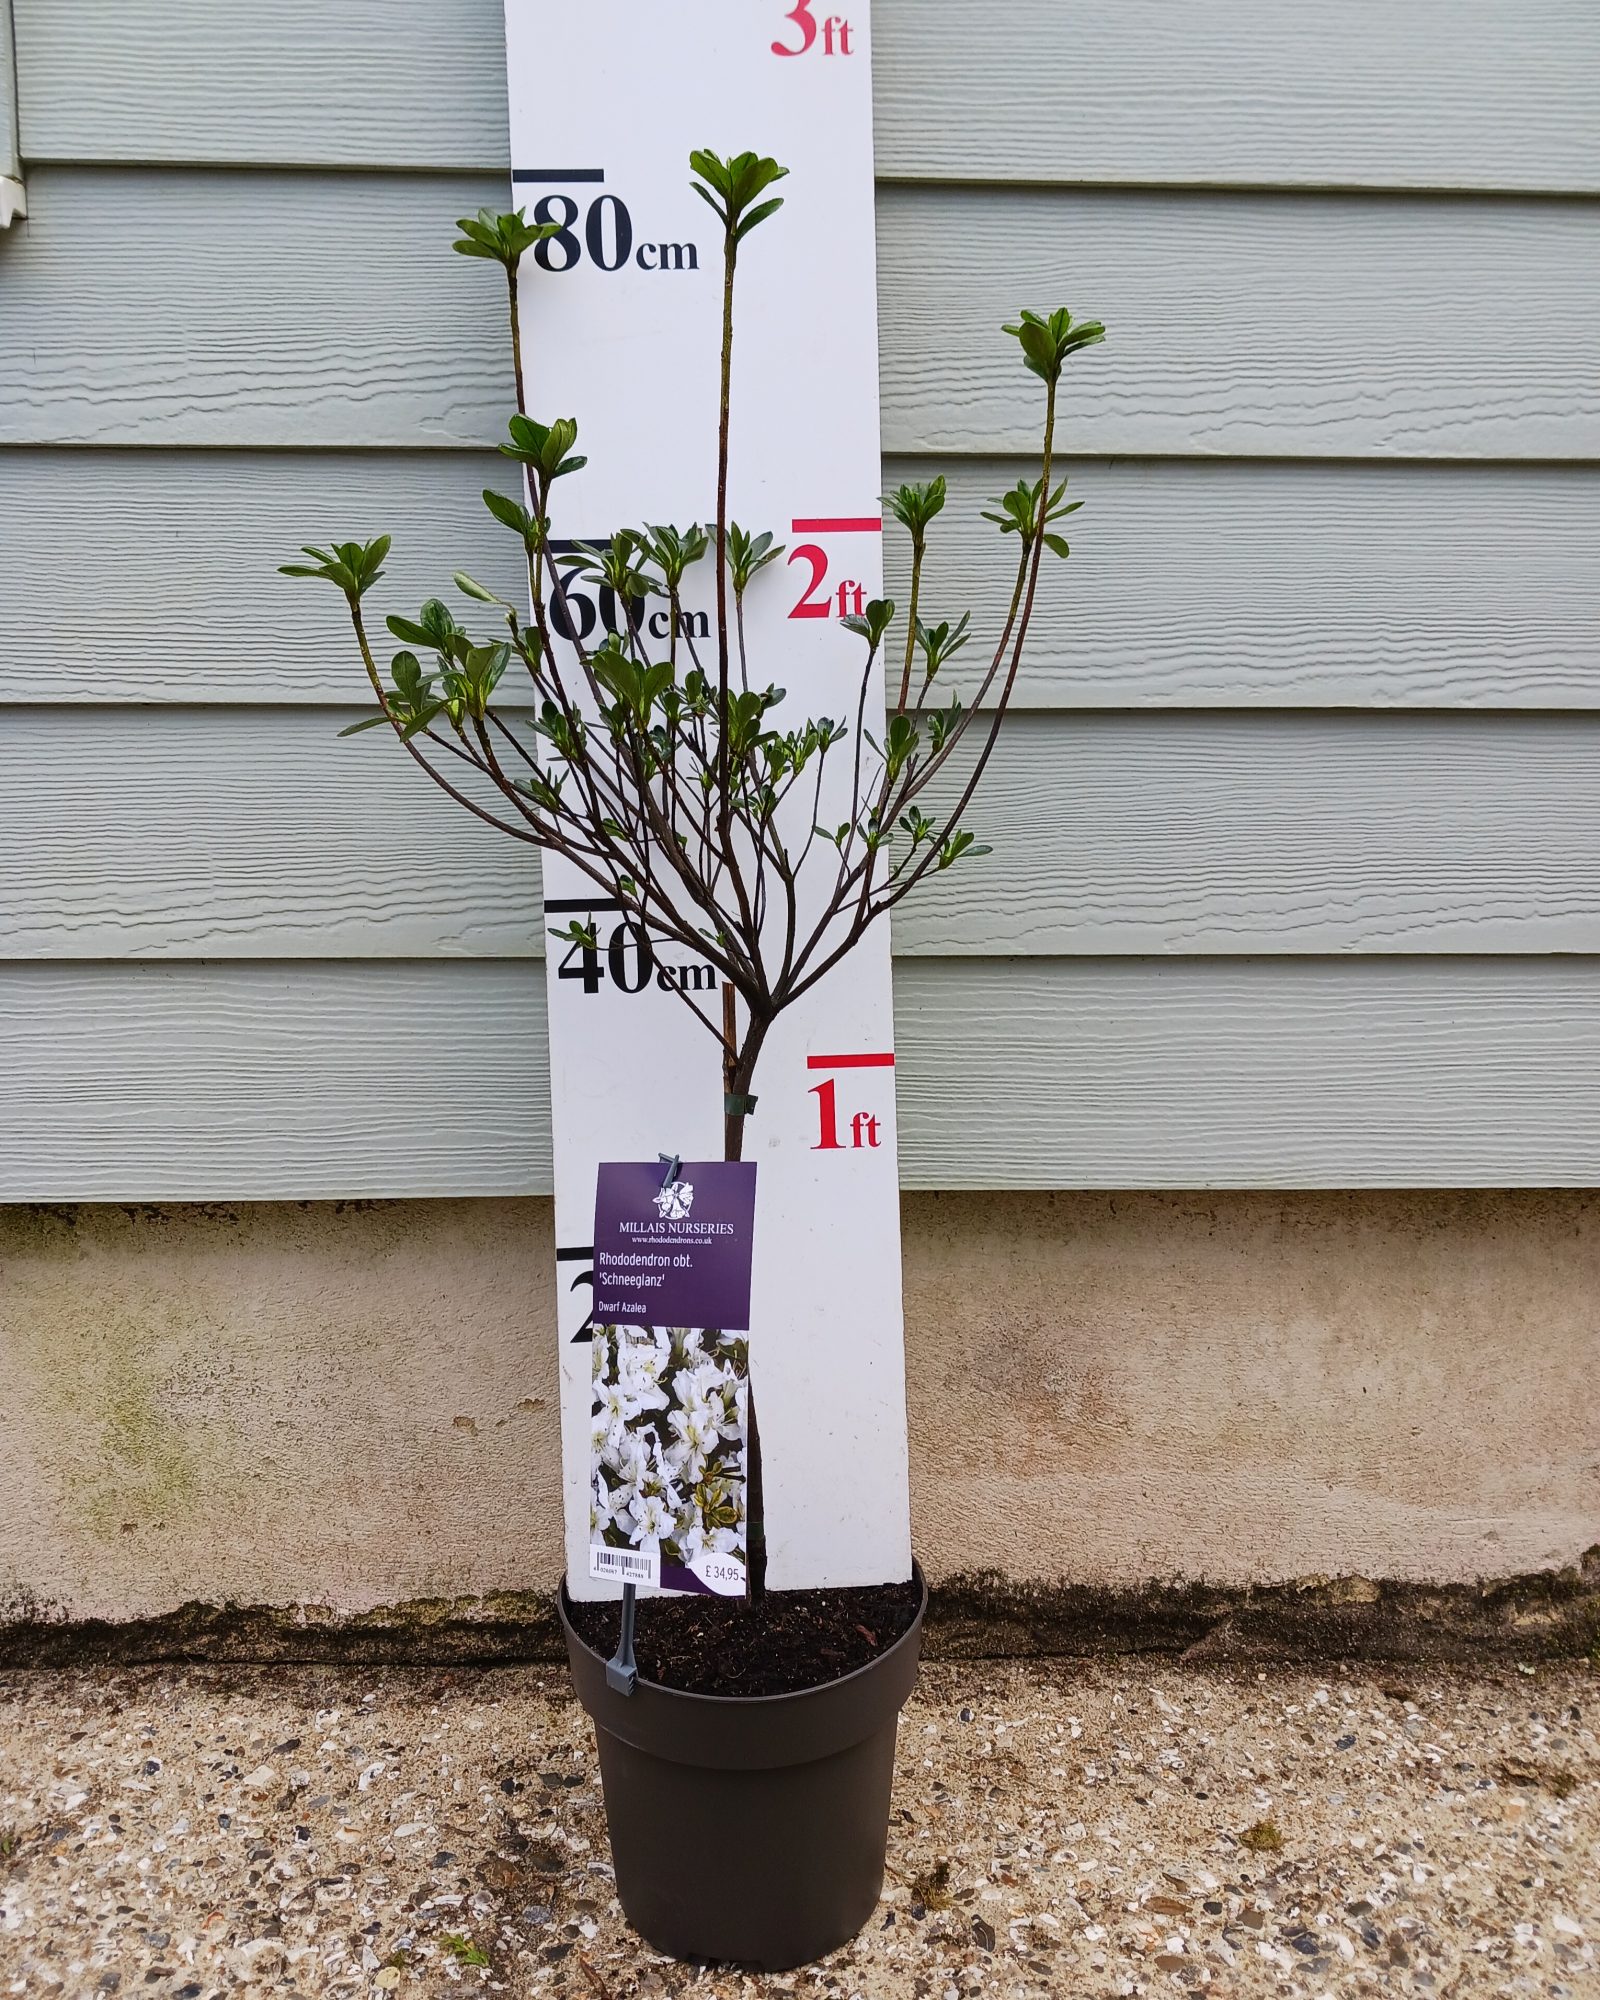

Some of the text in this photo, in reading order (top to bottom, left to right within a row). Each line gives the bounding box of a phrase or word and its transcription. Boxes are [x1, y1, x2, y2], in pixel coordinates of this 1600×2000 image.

[619, 1222, 734, 1235] MILLAIS NURSERIES
[631, 1235, 713, 1245] www.rhododendrons.co.uk
[599, 1252, 693, 1268] Rhododendron obt.
[599, 1272, 665, 1289] 'Schneeglanz'
[598, 1301, 647, 1313] Dwarf Azalea
